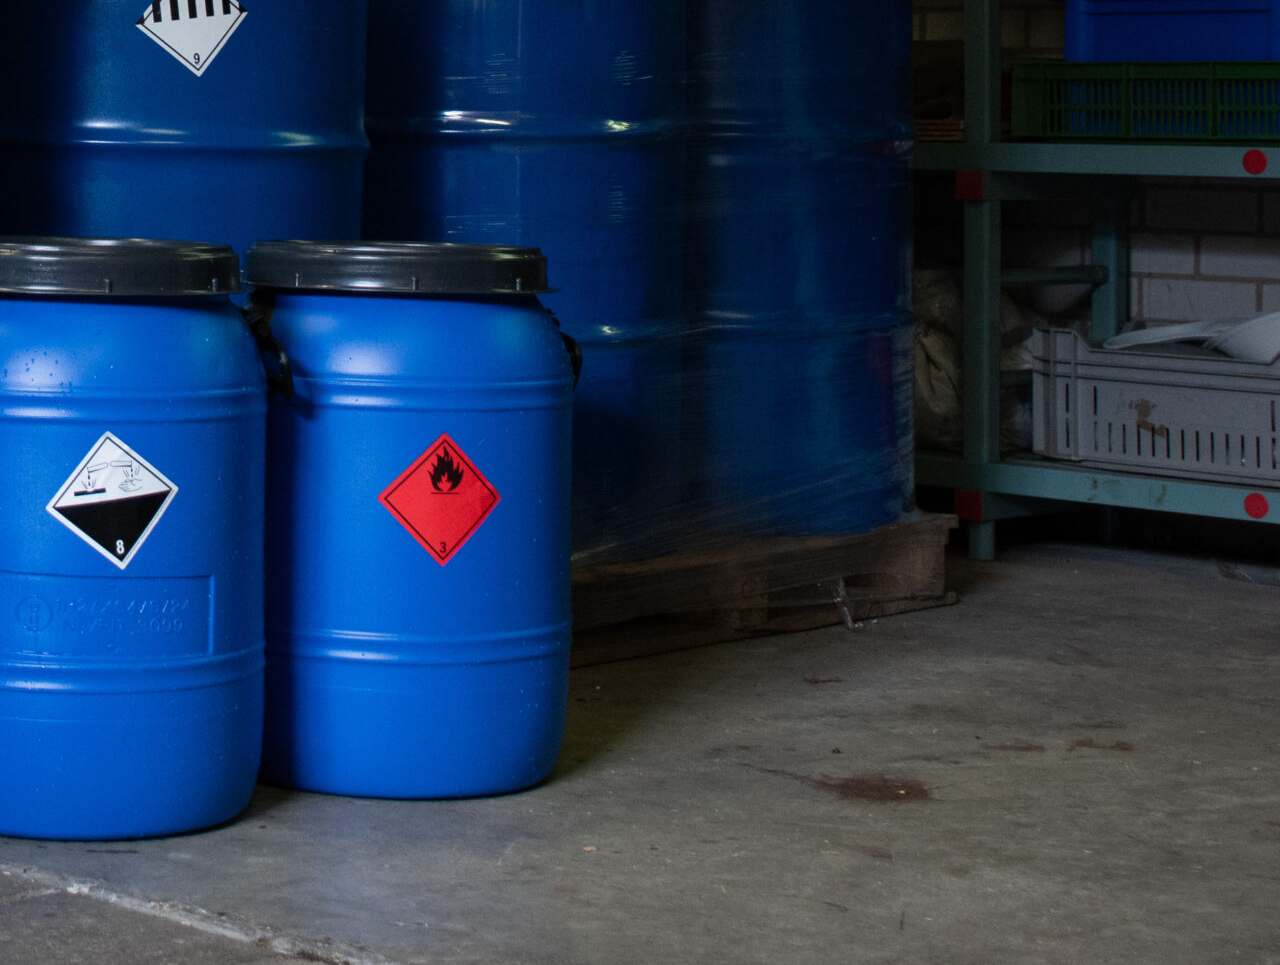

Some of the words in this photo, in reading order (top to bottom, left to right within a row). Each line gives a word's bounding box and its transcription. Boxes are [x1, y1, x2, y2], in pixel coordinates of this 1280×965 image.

[193, 52, 200, 64] 9
[116, 539, 125, 554] 8
[440, 541, 446, 553] 3
